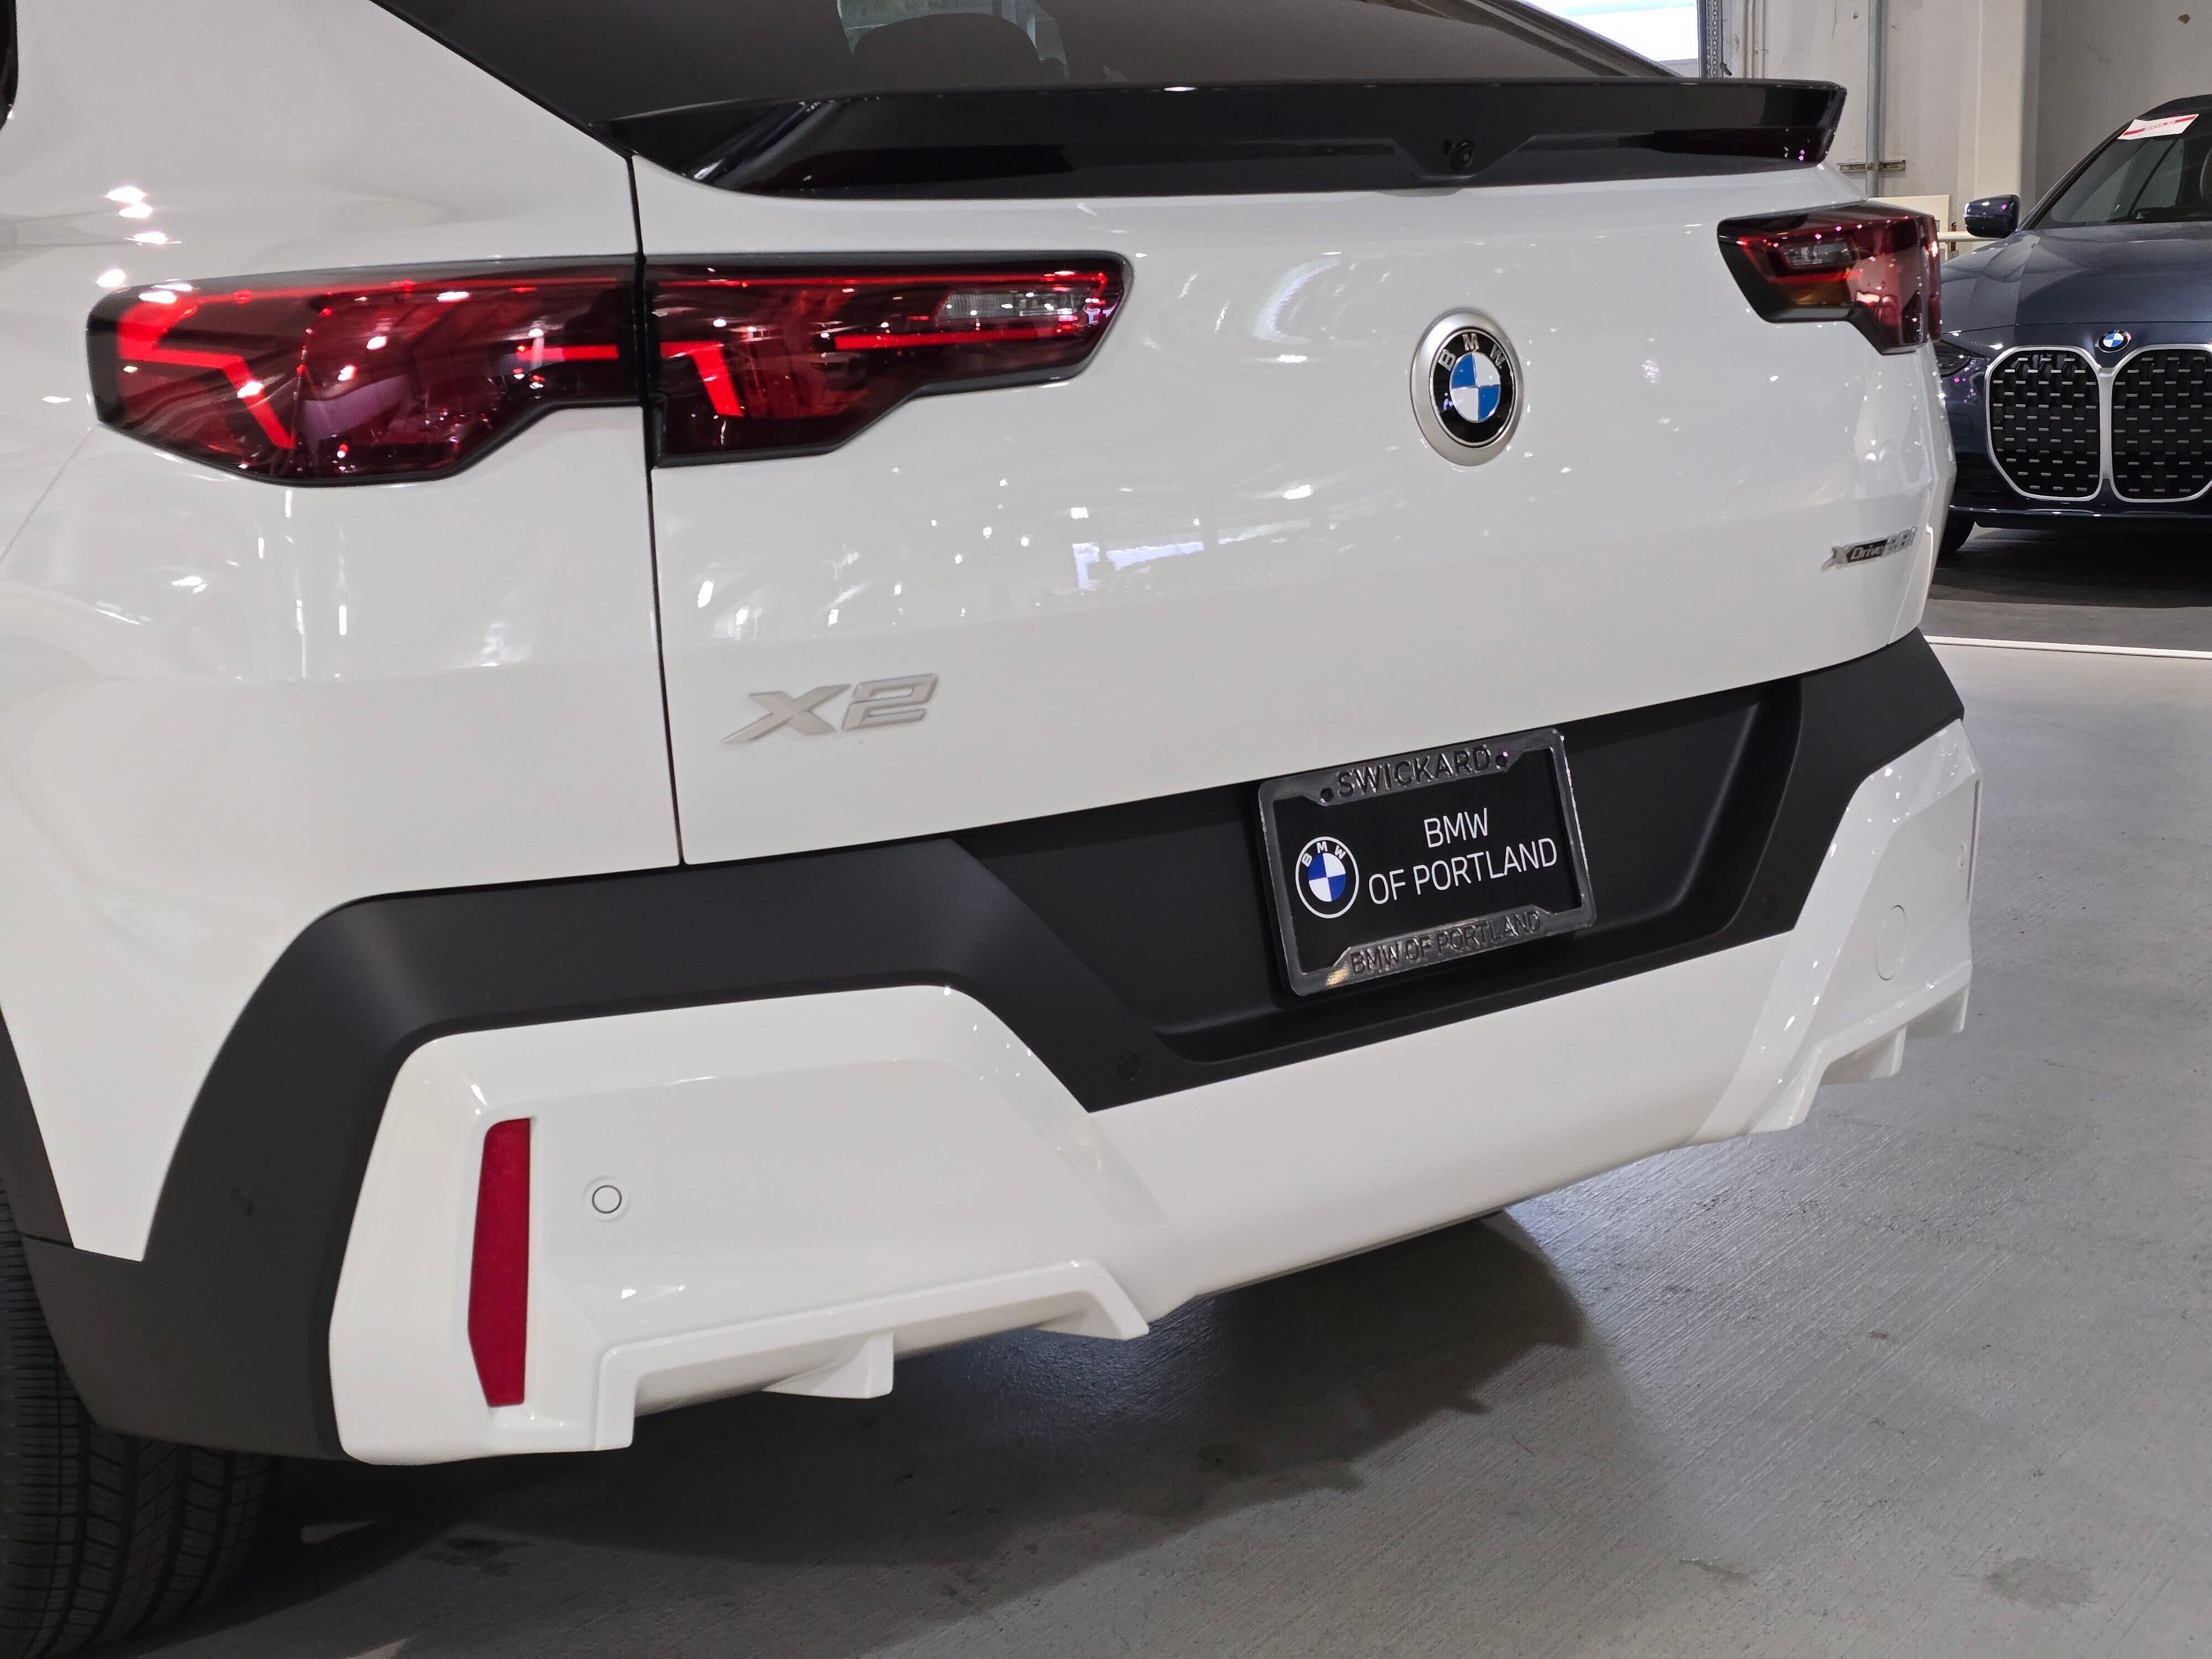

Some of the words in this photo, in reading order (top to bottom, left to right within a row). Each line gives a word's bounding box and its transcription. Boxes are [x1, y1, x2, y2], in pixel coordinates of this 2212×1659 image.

[1438, 333, 1505, 371] BMW
[721, 673, 938, 743] X2
[1337, 744, 1491, 797] SWICKARD
[1301, 841, 1346, 867] BMW
[1424, 807, 1488, 848] BMW
[1369, 869, 1406, 904] OF
[1413, 838, 1557, 895] PORTLAND
[1350, 942, 1400, 974] BMW
[1406, 936, 1432, 961] OF
[1438, 910, 1542, 955] PORTLAND
